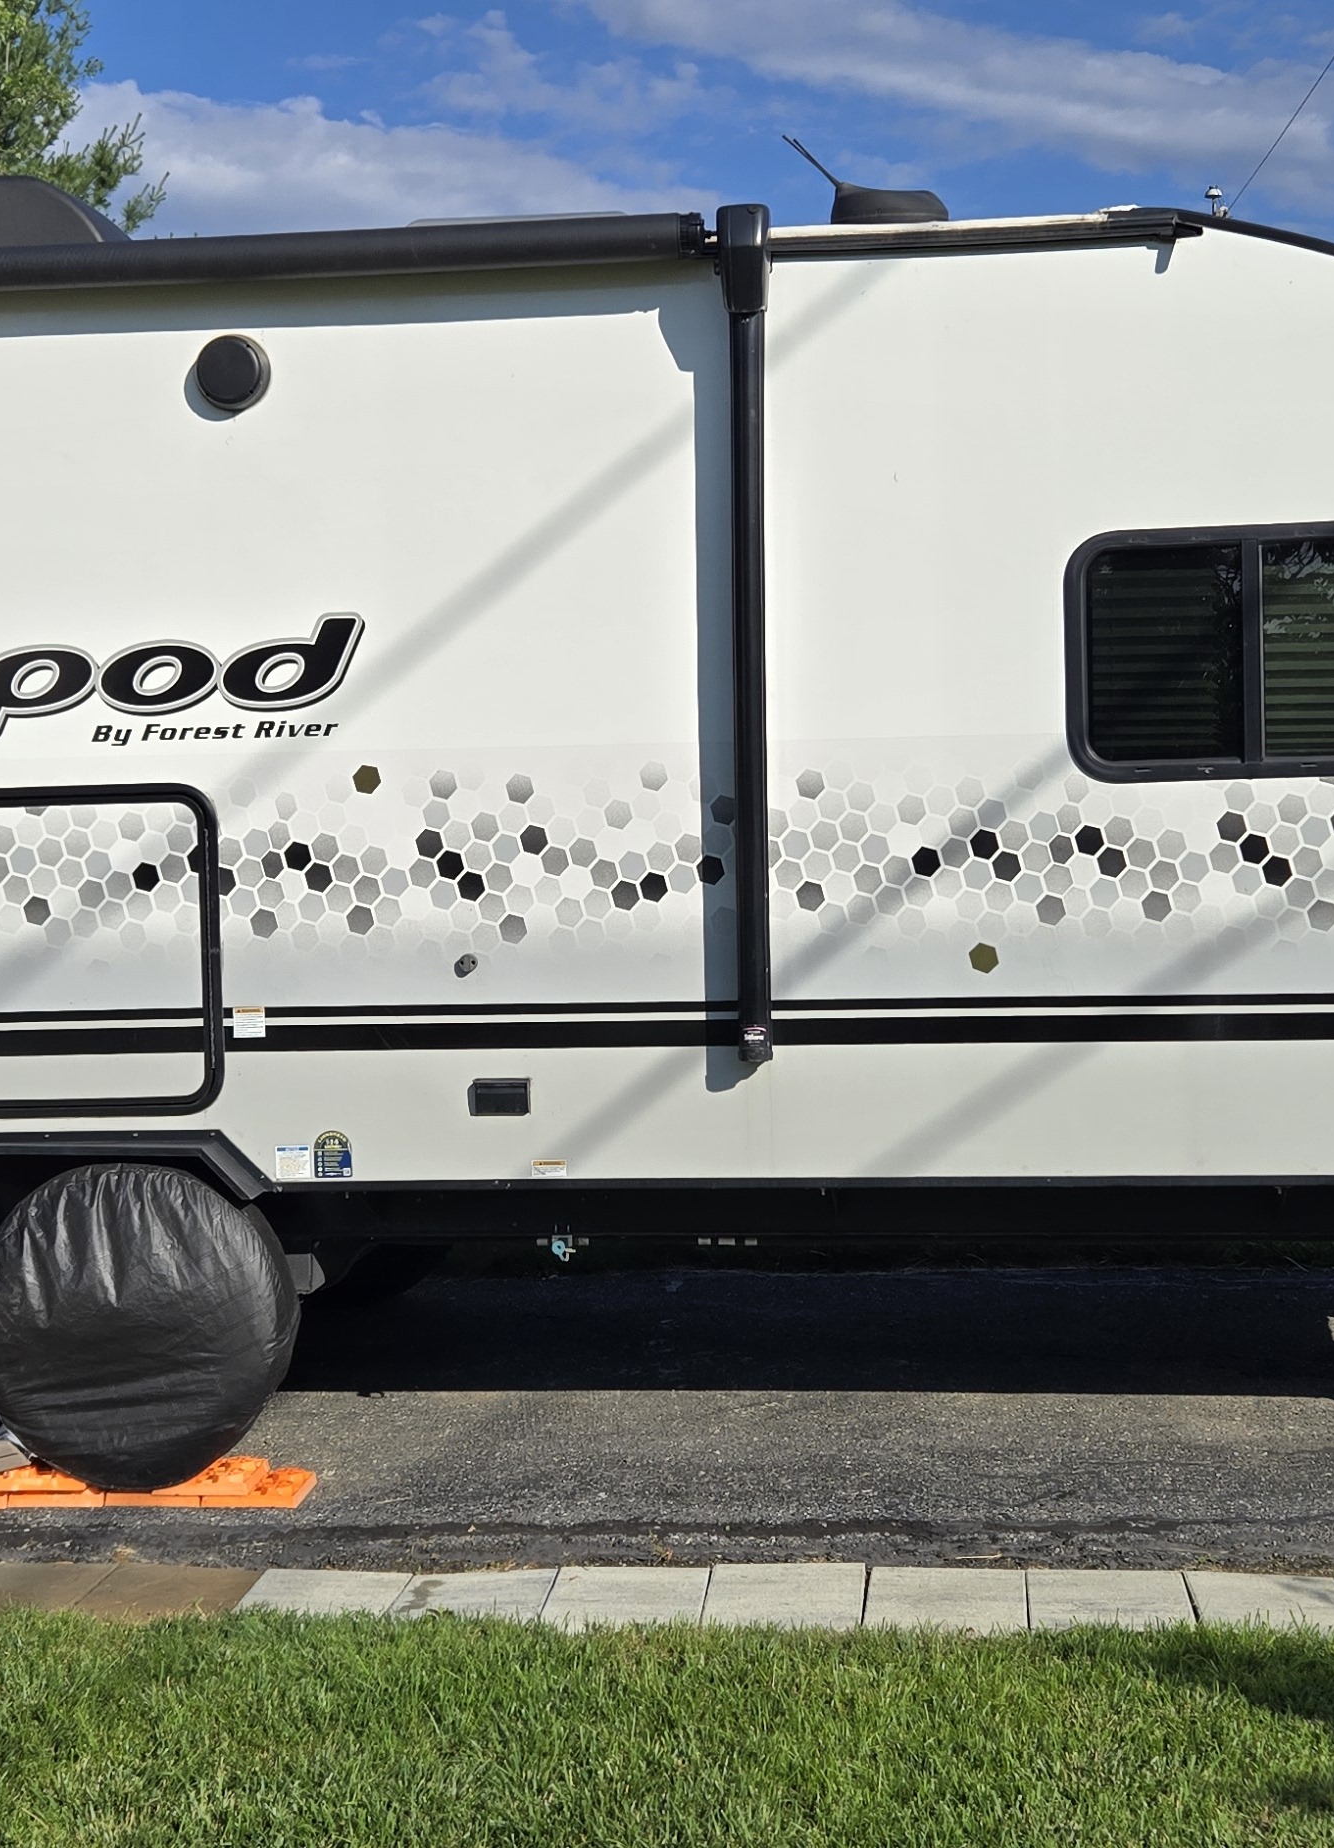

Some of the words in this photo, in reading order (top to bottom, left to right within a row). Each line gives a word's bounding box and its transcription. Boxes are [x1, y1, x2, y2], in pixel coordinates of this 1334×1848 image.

[91, 725, 132, 746] By
[141, 723, 246, 741] Forest
[254, 720, 339, 739] River
